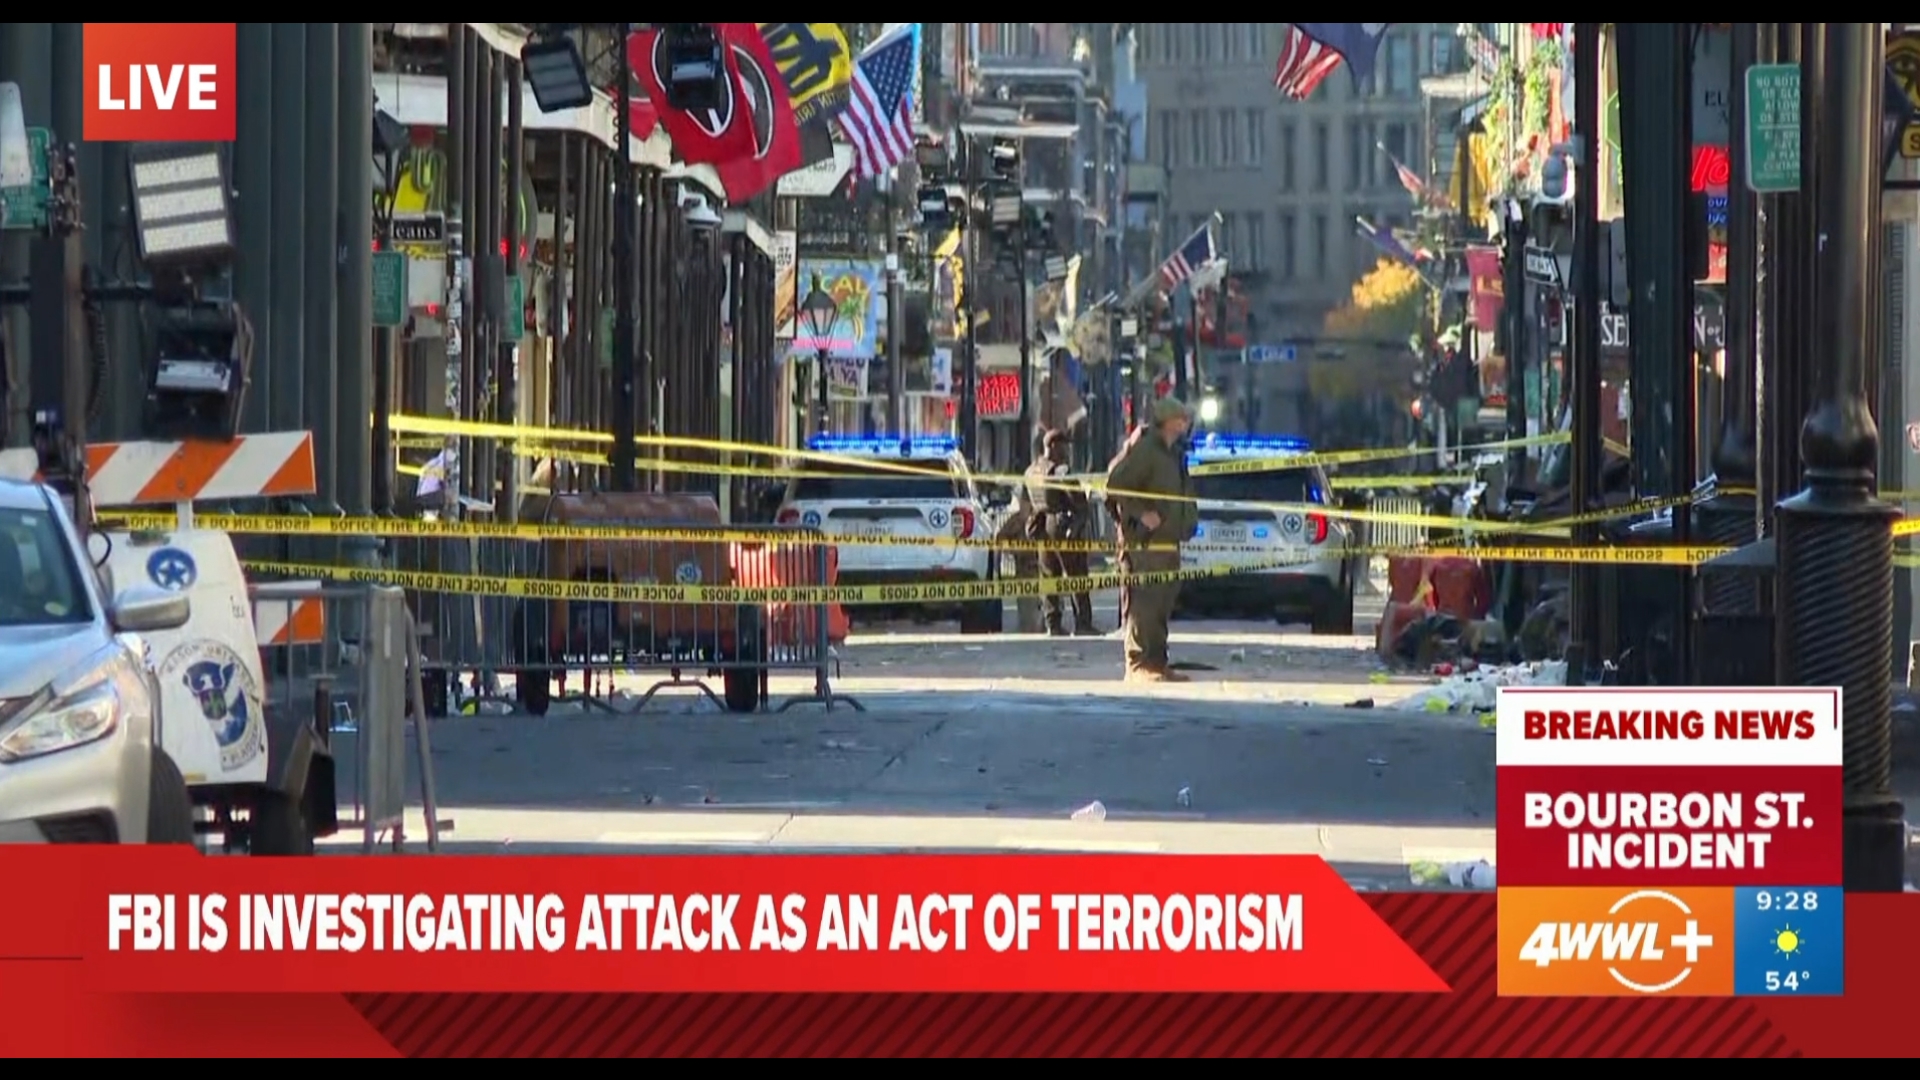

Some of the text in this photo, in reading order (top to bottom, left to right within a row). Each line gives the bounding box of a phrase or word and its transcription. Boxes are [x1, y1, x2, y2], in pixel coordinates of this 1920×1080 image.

[349, 570, 507, 593] POLICE LINE DO NOT CROSS
[1056, 577, 1094, 592] CROSS
[1098, 575, 1121, 588] NOT
[1125, 574, 1140, 587] DO
[523, 581, 684, 600] POLICE LINE DO NOT CROSS
[701, 586, 863, 600] POLICE LINE DO NOT CROSS
[880, 580, 1040, 599] POLICE LINE DO NOT CROSS
